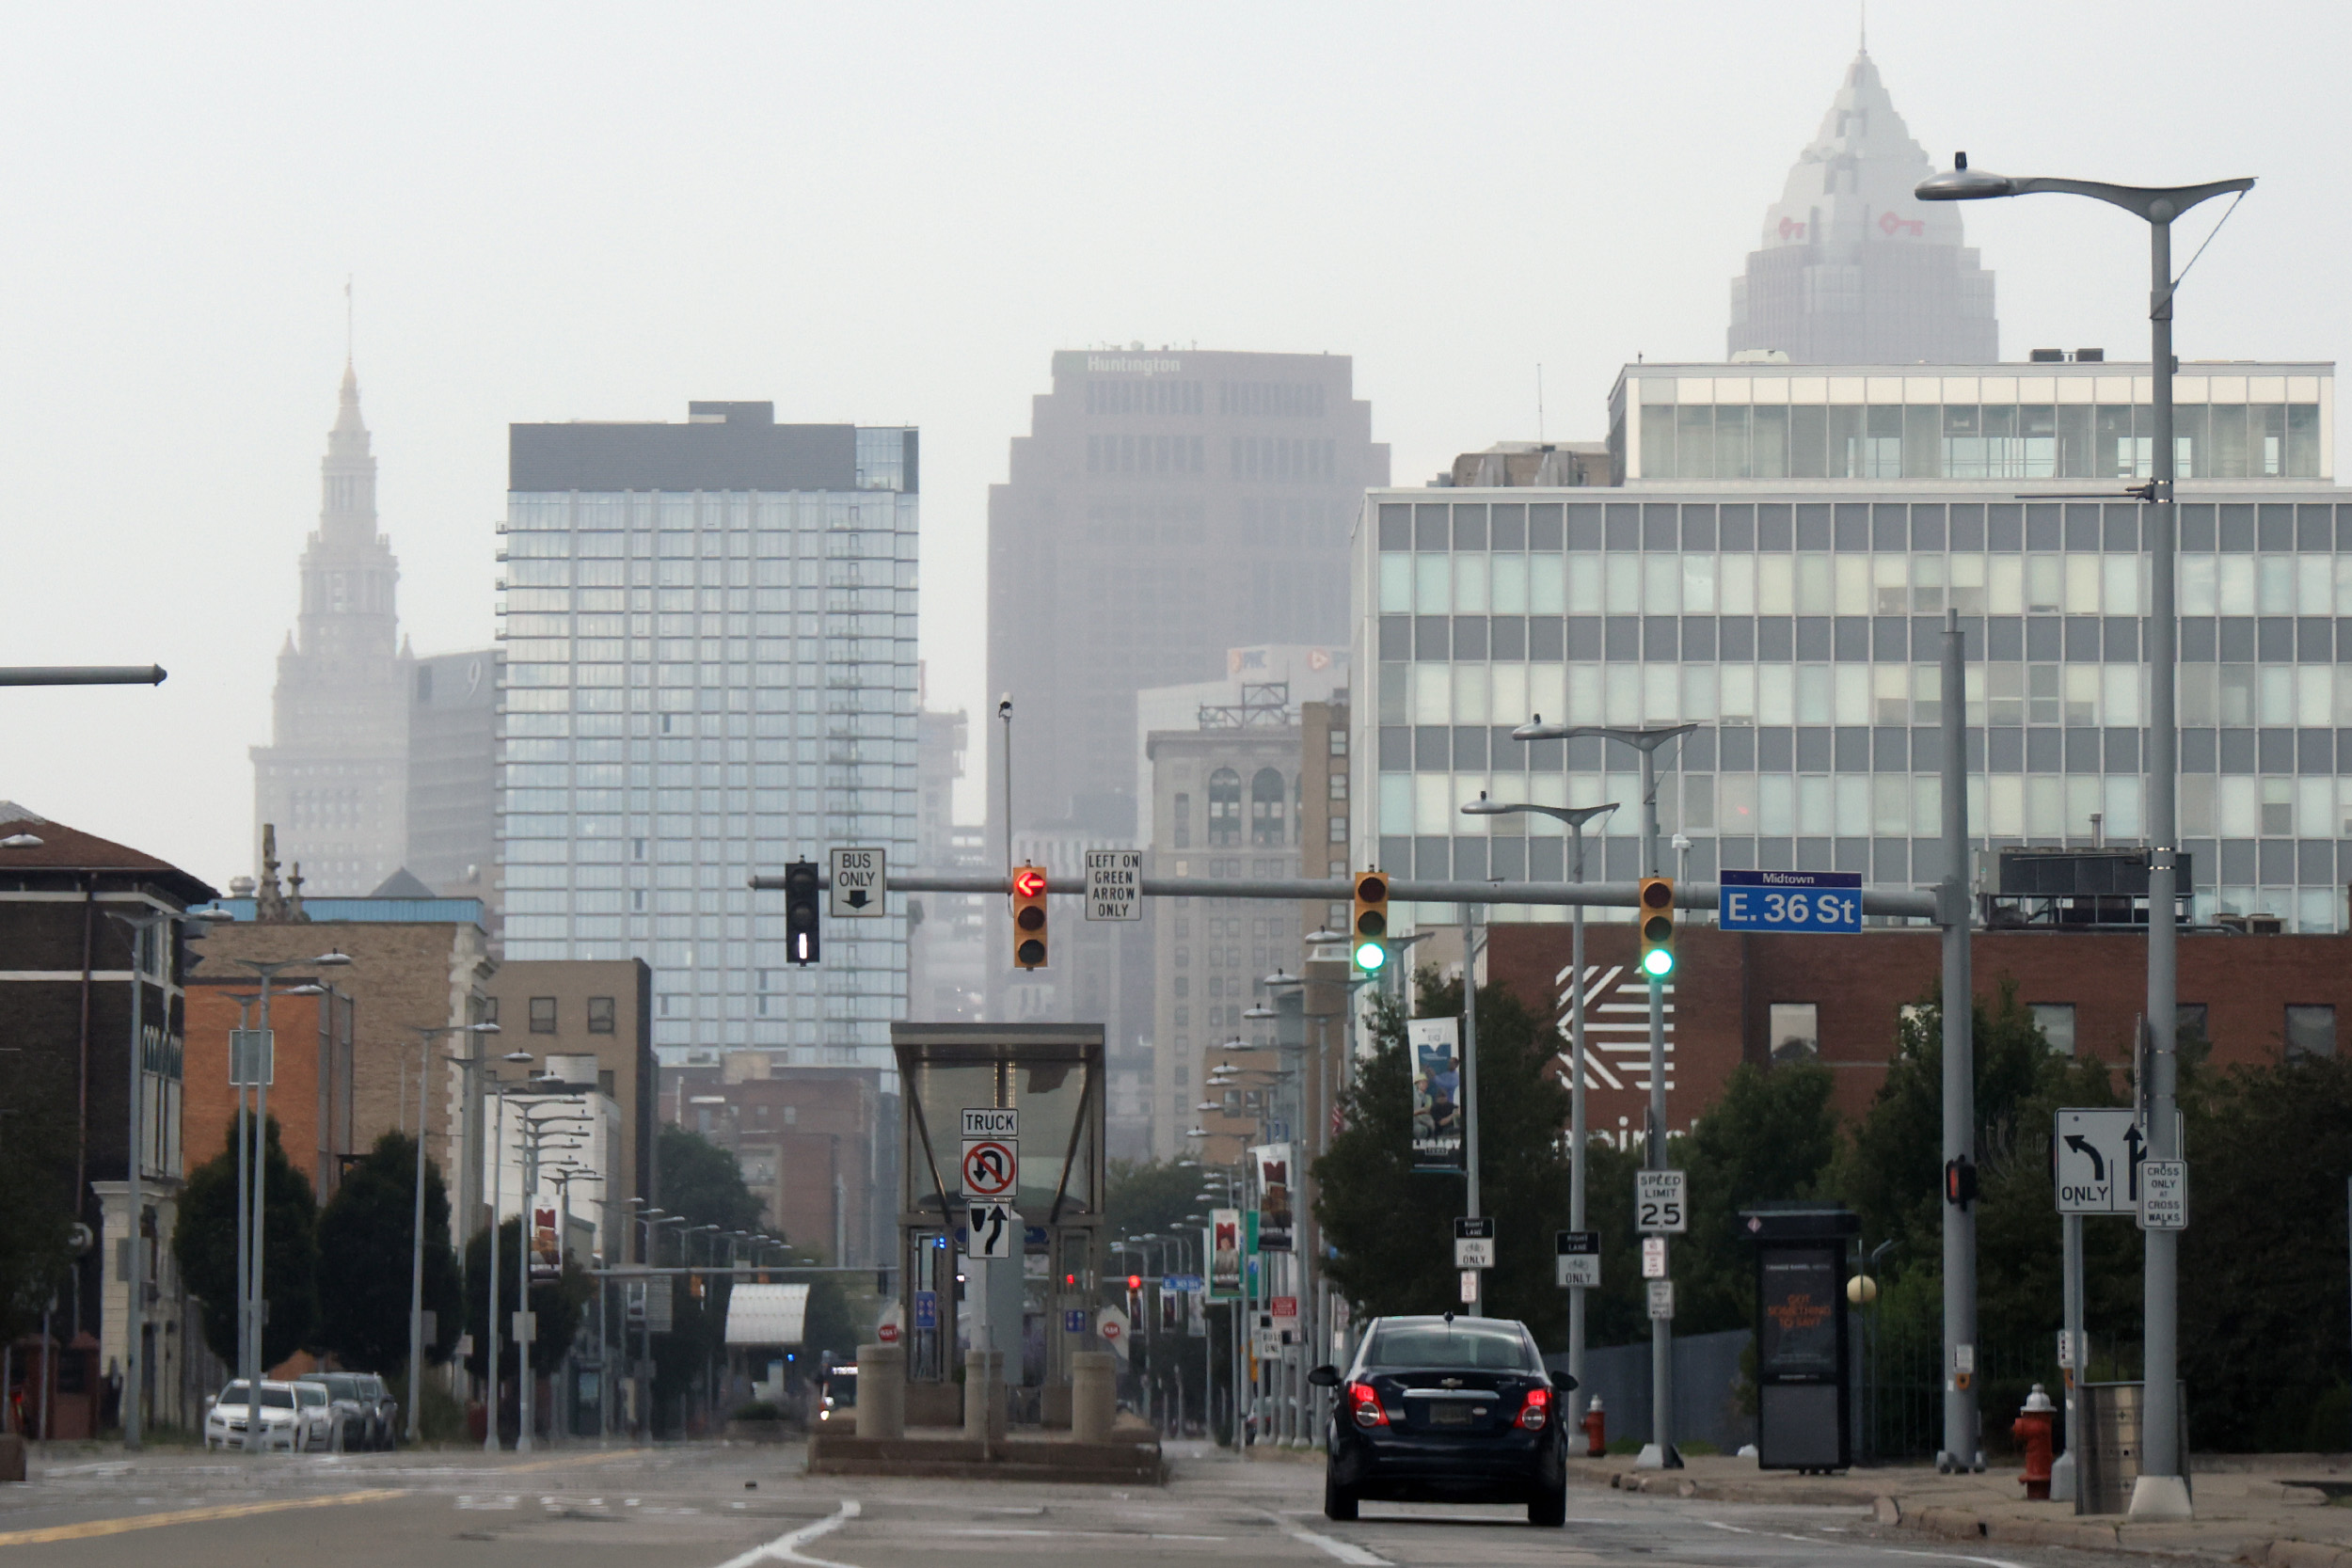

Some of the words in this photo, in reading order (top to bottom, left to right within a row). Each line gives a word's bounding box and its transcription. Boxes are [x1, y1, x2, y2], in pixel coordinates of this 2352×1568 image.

[1087, 356, 1181, 375] Huntington
[842, 853, 871, 869] BUS
[1088, 854, 1117, 868] LEFT
[1122, 854, 1139, 868] ON
[839, 871, 876, 887] ONLY
[1094, 871, 1133, 884] GREEN
[1762, 873, 1815, 884] Midtown
[1092, 887, 1135, 900] ARROW
[1098, 903, 1129, 917] ONLY
[1728, 893, 1757, 922] E.
[1764, 894, 1809, 923] 36
[1816, 895, 1855, 924] St
[965, 1115, 1014, 1131] TRUCK
[2147, 1167, 2180, 1176] CROSS
[1641, 1175, 1681, 1186] SPEED
[2151, 1180, 2177, 1188] ONLY
[1645, 1188, 1677, 1198] LIMIT
[2061, 1186, 2108, 1201] ONLY
[2148, 1201, 2181, 1210] CROSS
[1641, 1203, 1681, 1226] 25
[2148, 1213, 2181, 1222] WALKS
[1568, 1243, 1588, 1251] LANE
[1463, 1255, 1486, 1264] ONLY
[1565, 1273, 1592, 1284] ONLY
